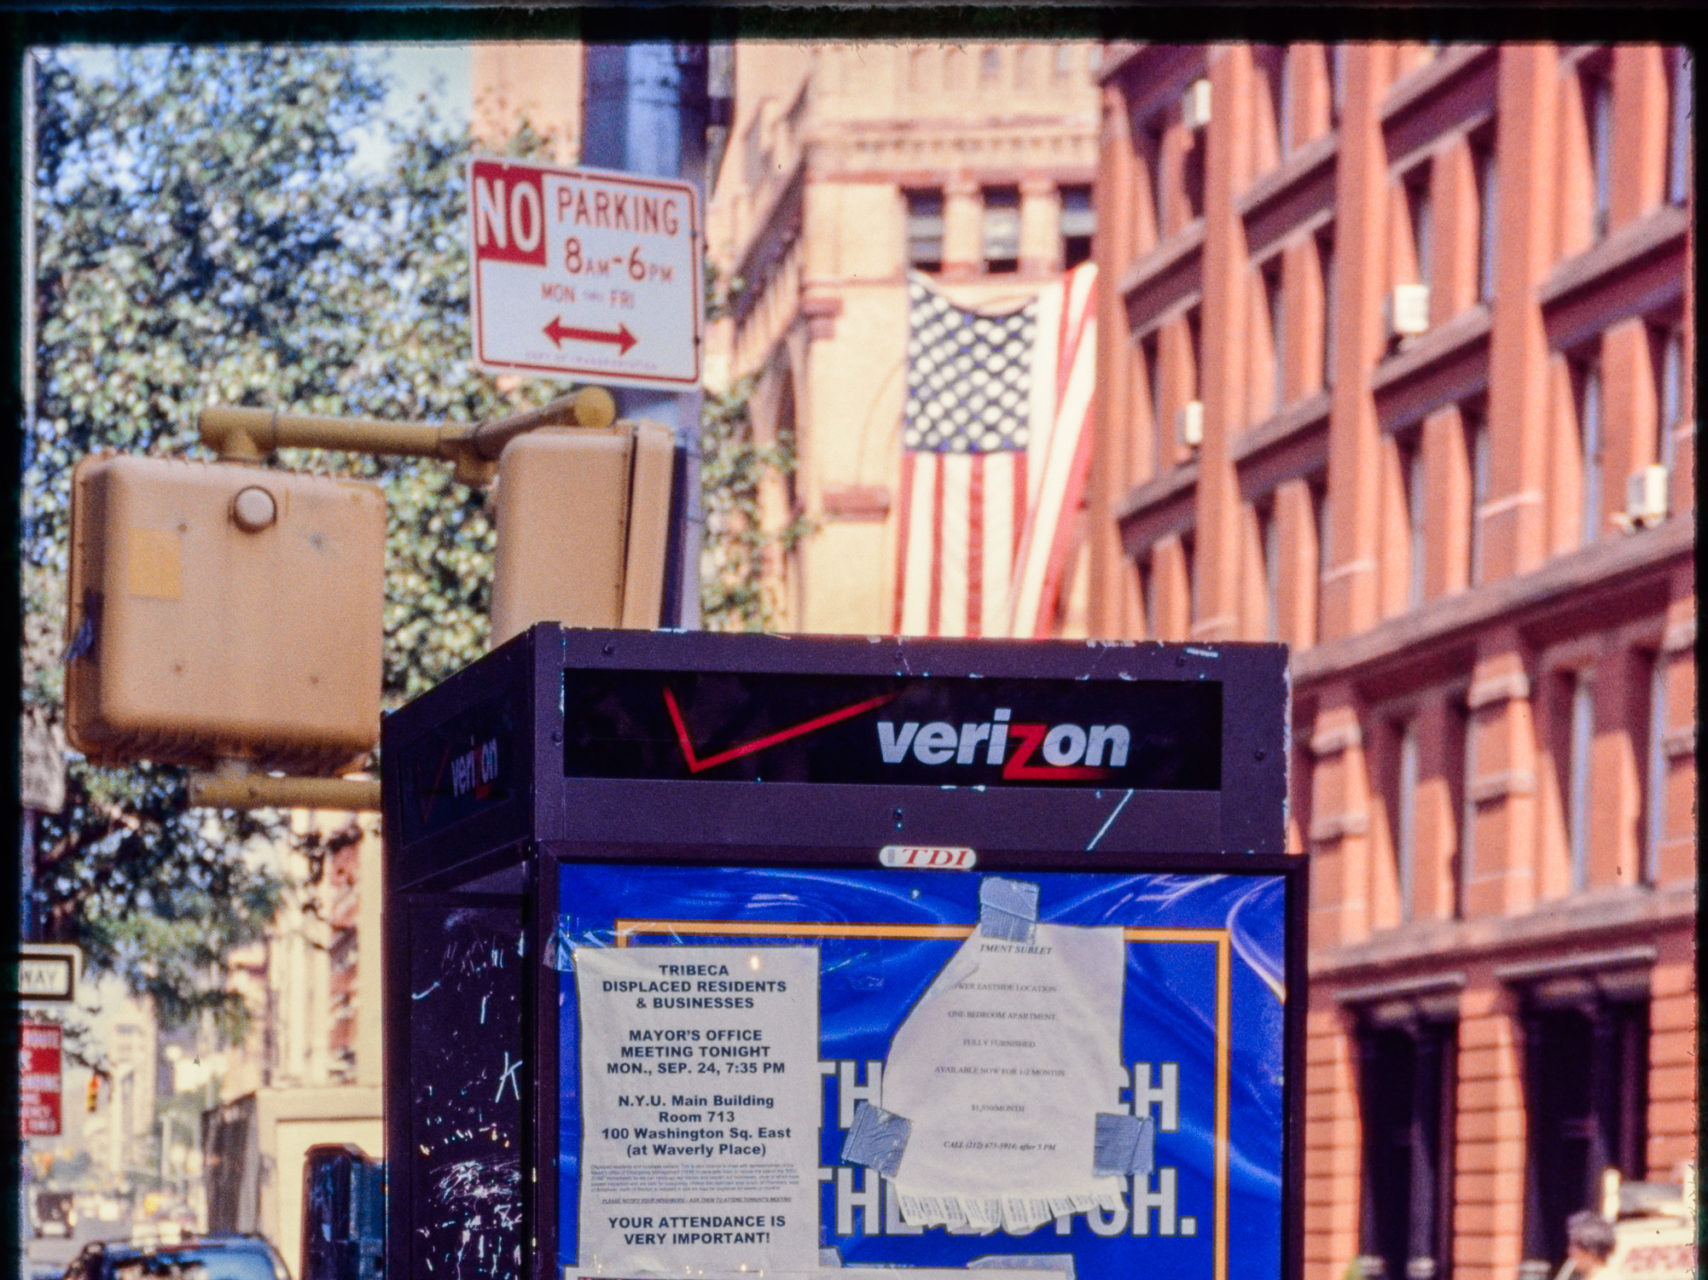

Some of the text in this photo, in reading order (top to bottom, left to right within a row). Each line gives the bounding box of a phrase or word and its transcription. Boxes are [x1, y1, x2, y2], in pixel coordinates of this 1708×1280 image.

[474, 177, 679, 252] NO PARKING
[876, 708, 1130, 780] verizon
[902, 849, 970, 868] TDI
[659, 965, 728, 976] TRIBECA
[603, 981, 786, 992] DISPLACED RESIDENTS
[636, 998, 754, 1008] & BUSINESSES
[629, 1030, 761, 1041] MAYOR'S OFFICE
[621, 1046, 770, 1057] MEETING TONIGHT
[658, 1063, 691, 1073] SEP.
[698, 1062, 720, 1075] 24,
[726, 1062, 757, 1073] 7:35
[763, 1063, 784, 1073] PM
[619, 1095, 774, 1108] N.Y.U. Main Building
[659, 1111, 735, 1122] Room 713
[602, 1127, 791, 1141] 100 Washington Sq. East
[627, 1144, 766, 1158] (at Waverly Place)
[609, 1216, 785, 1228] YOUR ATTENDANCE IS
[624, 1232, 769, 1245] VERY IMPORTANT!
